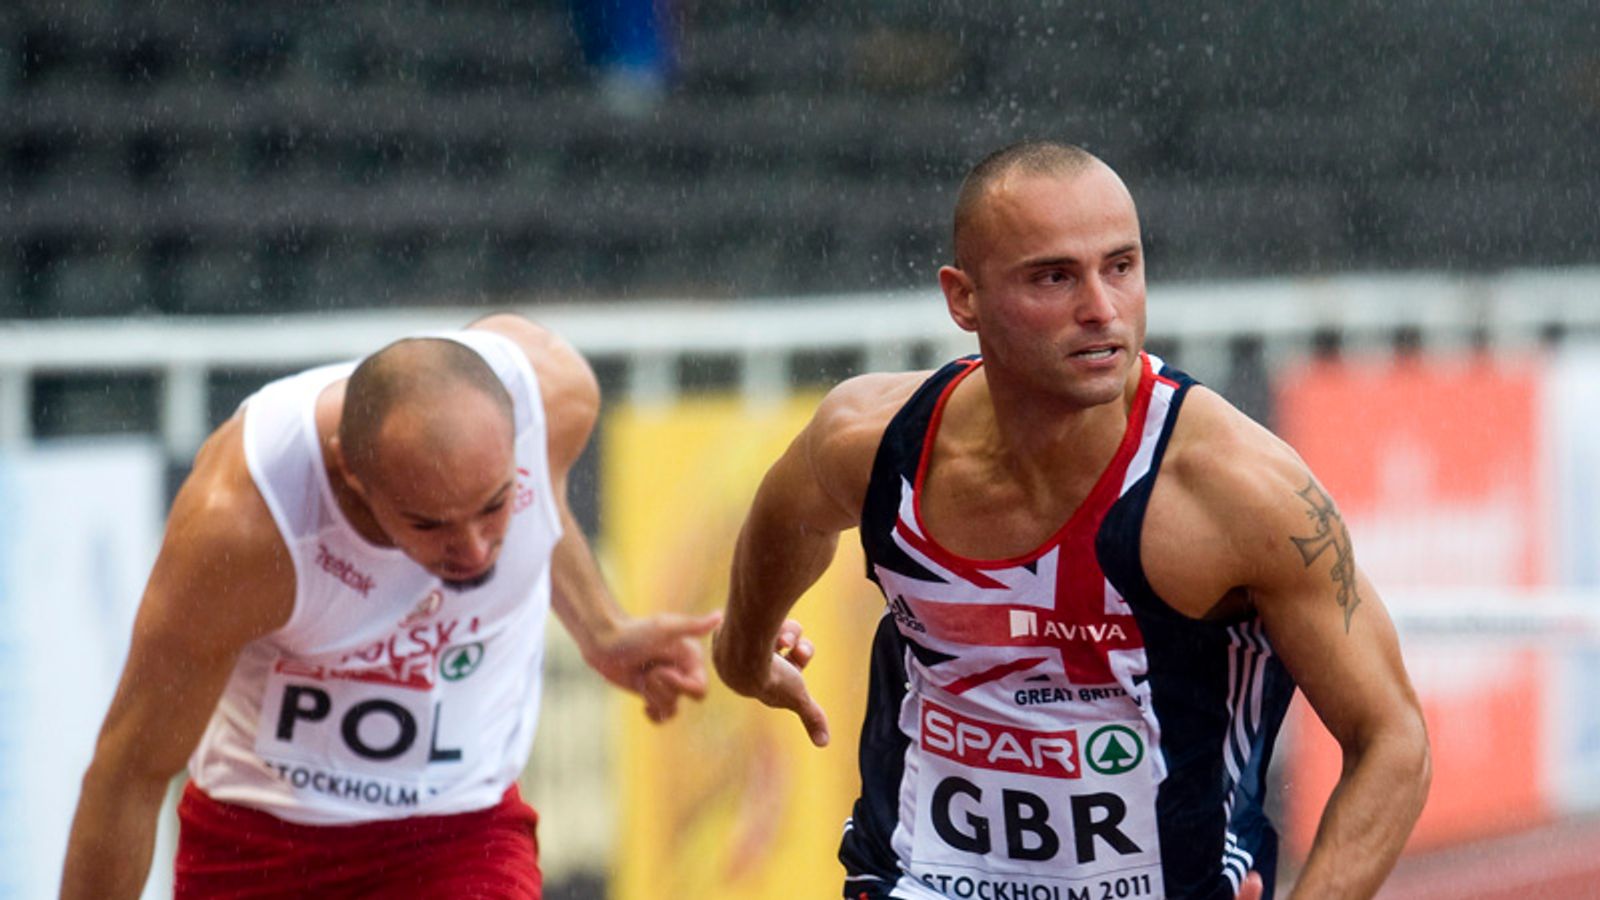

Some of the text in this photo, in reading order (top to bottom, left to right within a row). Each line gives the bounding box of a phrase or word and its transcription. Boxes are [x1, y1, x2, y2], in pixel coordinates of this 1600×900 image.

[341, 617, 479, 663] OLSK
[1044, 621, 1127, 642] AVIVA
[1014, 688, 1073, 706] GREAT
[276, 685, 463, 763] POL
[924, 709, 1076, 773] SPAR
[264, 760, 418, 808] TOCKHOLM
[930, 776, 1143, 865] GBR
[1099, 874, 1151, 900] 2011
